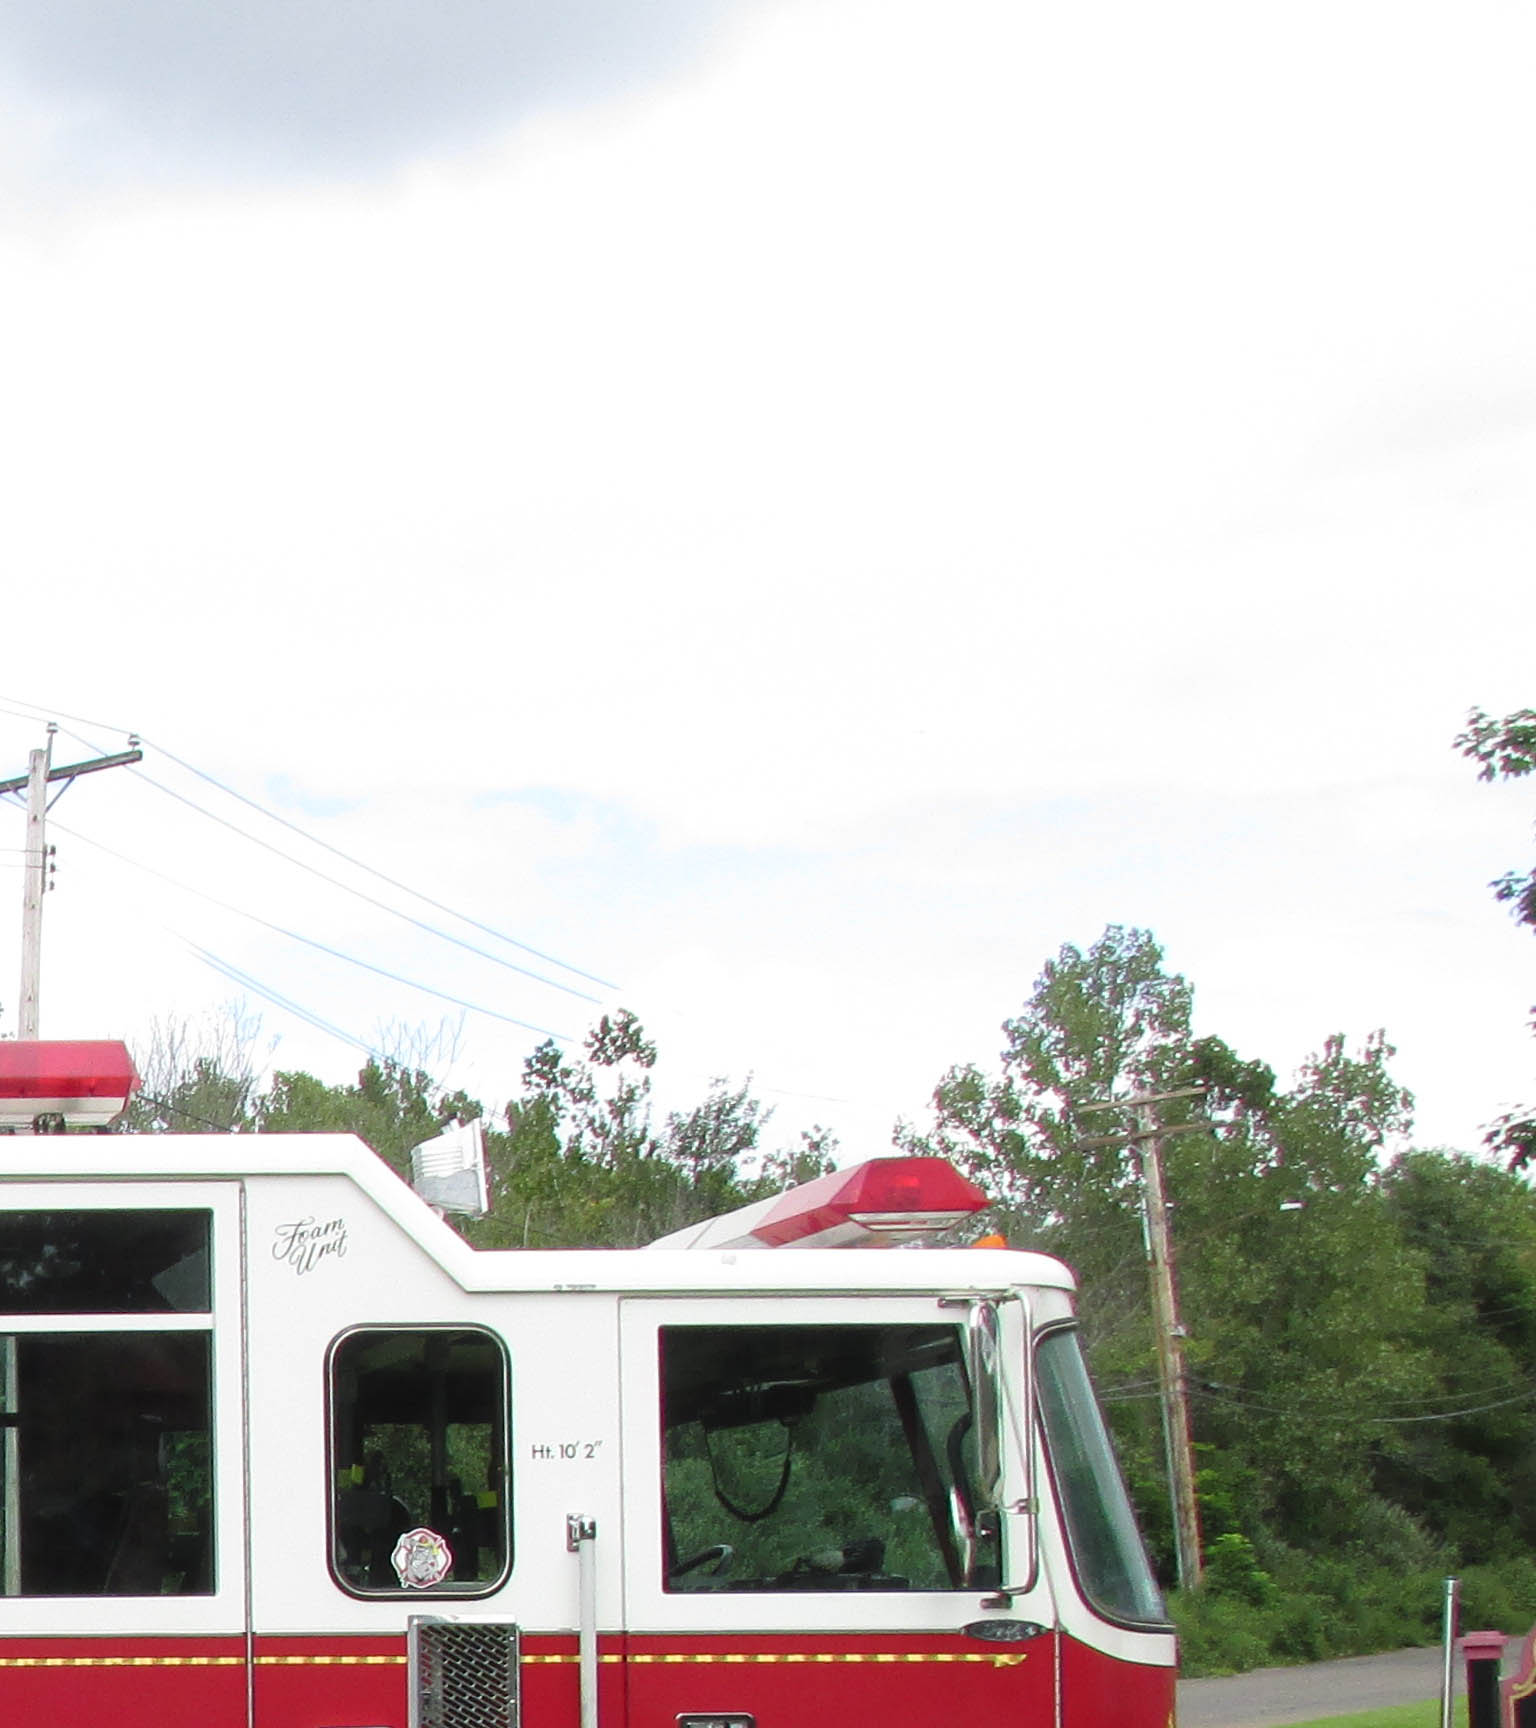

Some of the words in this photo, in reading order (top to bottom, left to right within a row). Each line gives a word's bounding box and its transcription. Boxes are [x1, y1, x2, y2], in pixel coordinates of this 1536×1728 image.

[272, 1215, 345, 1260] Foam
[288, 1230, 348, 1276] Unit
[531, 1444, 555, 1459] Ht.
